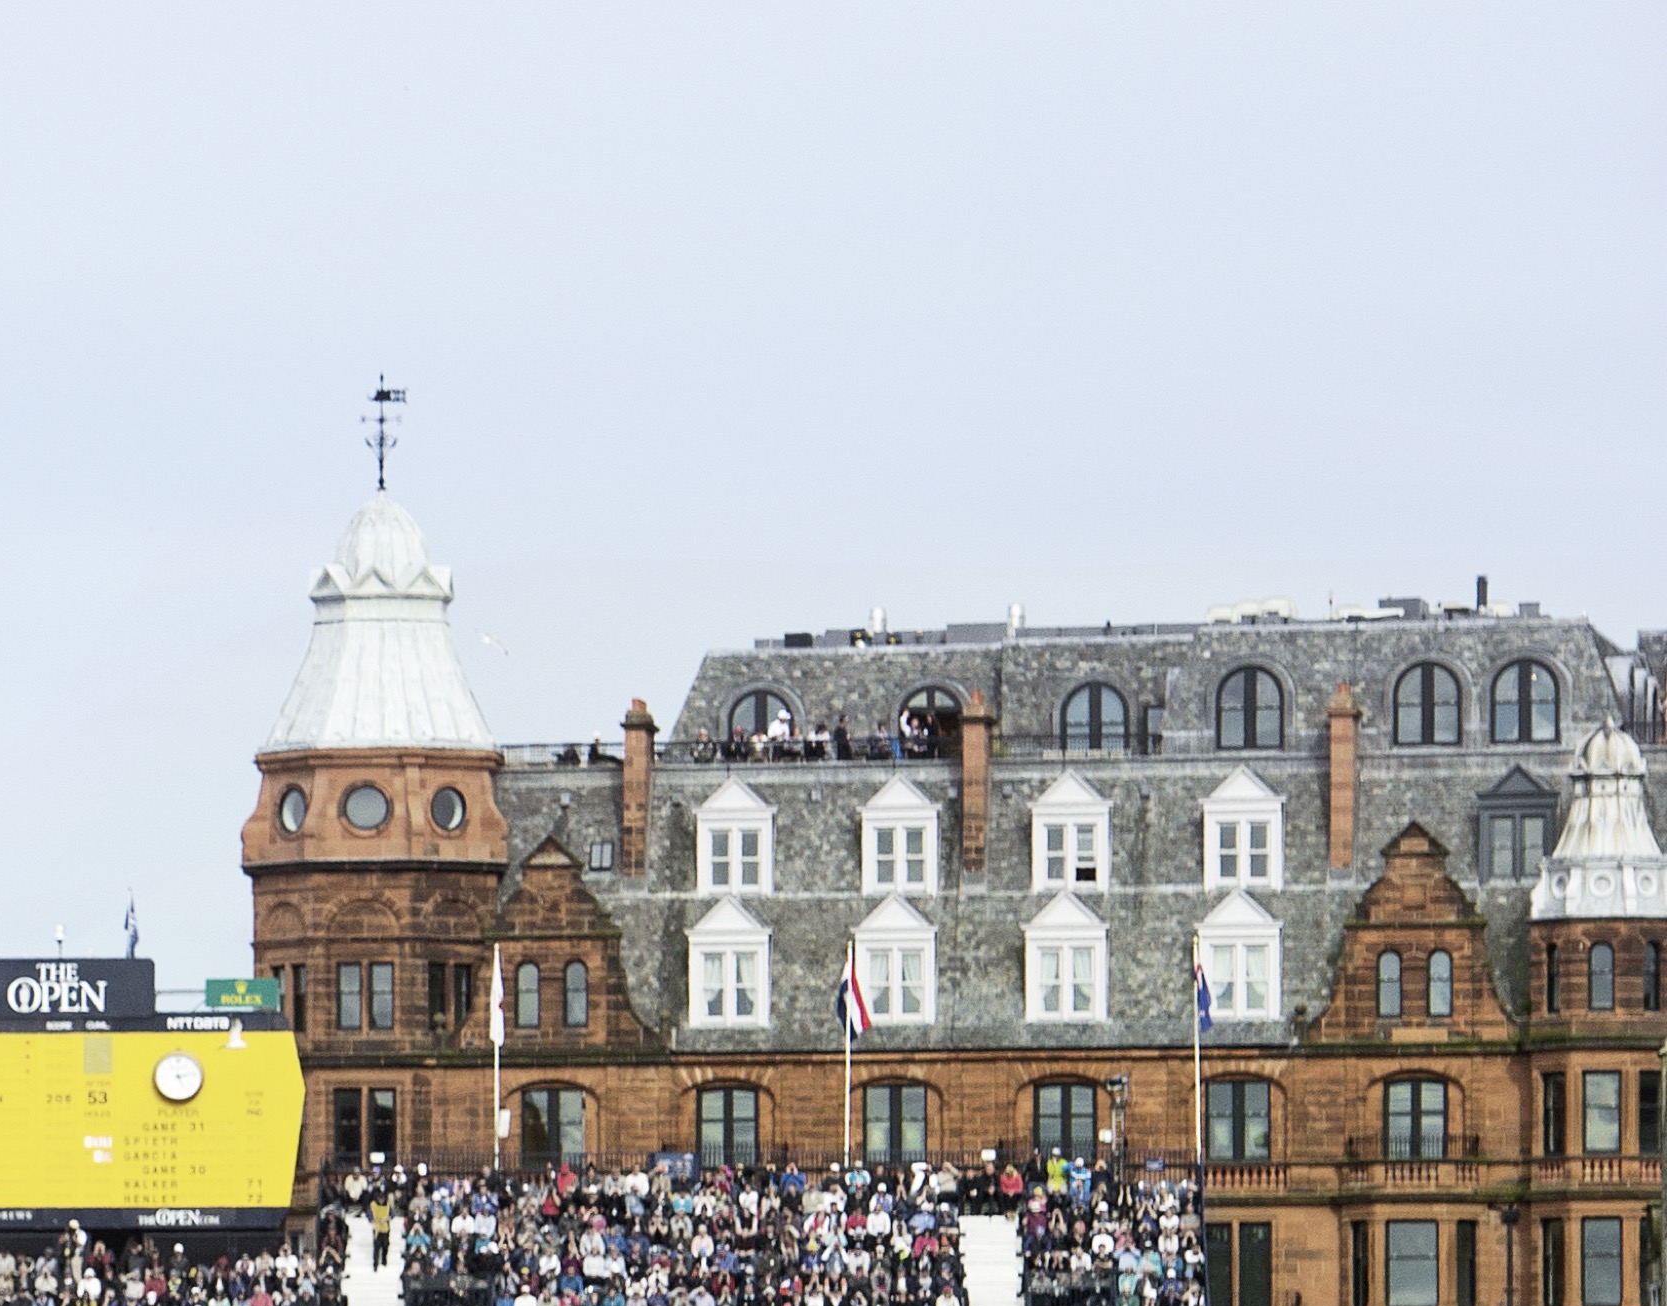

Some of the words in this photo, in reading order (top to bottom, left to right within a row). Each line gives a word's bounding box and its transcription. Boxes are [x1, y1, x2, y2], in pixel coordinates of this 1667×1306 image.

[35, 962, 79, 982] THE
[7, 976, 108, 1013] OPEN
[221, 994, 263, 1005] ROLEX
[87, 1090, 108, 1105] 53
[157, 1107, 199, 1117] PLAYER
[142, 1122, 178, 1132] GAME
[124, 1136, 178, 1146] SPIETH
[142, 1165, 178, 1175] GAME
